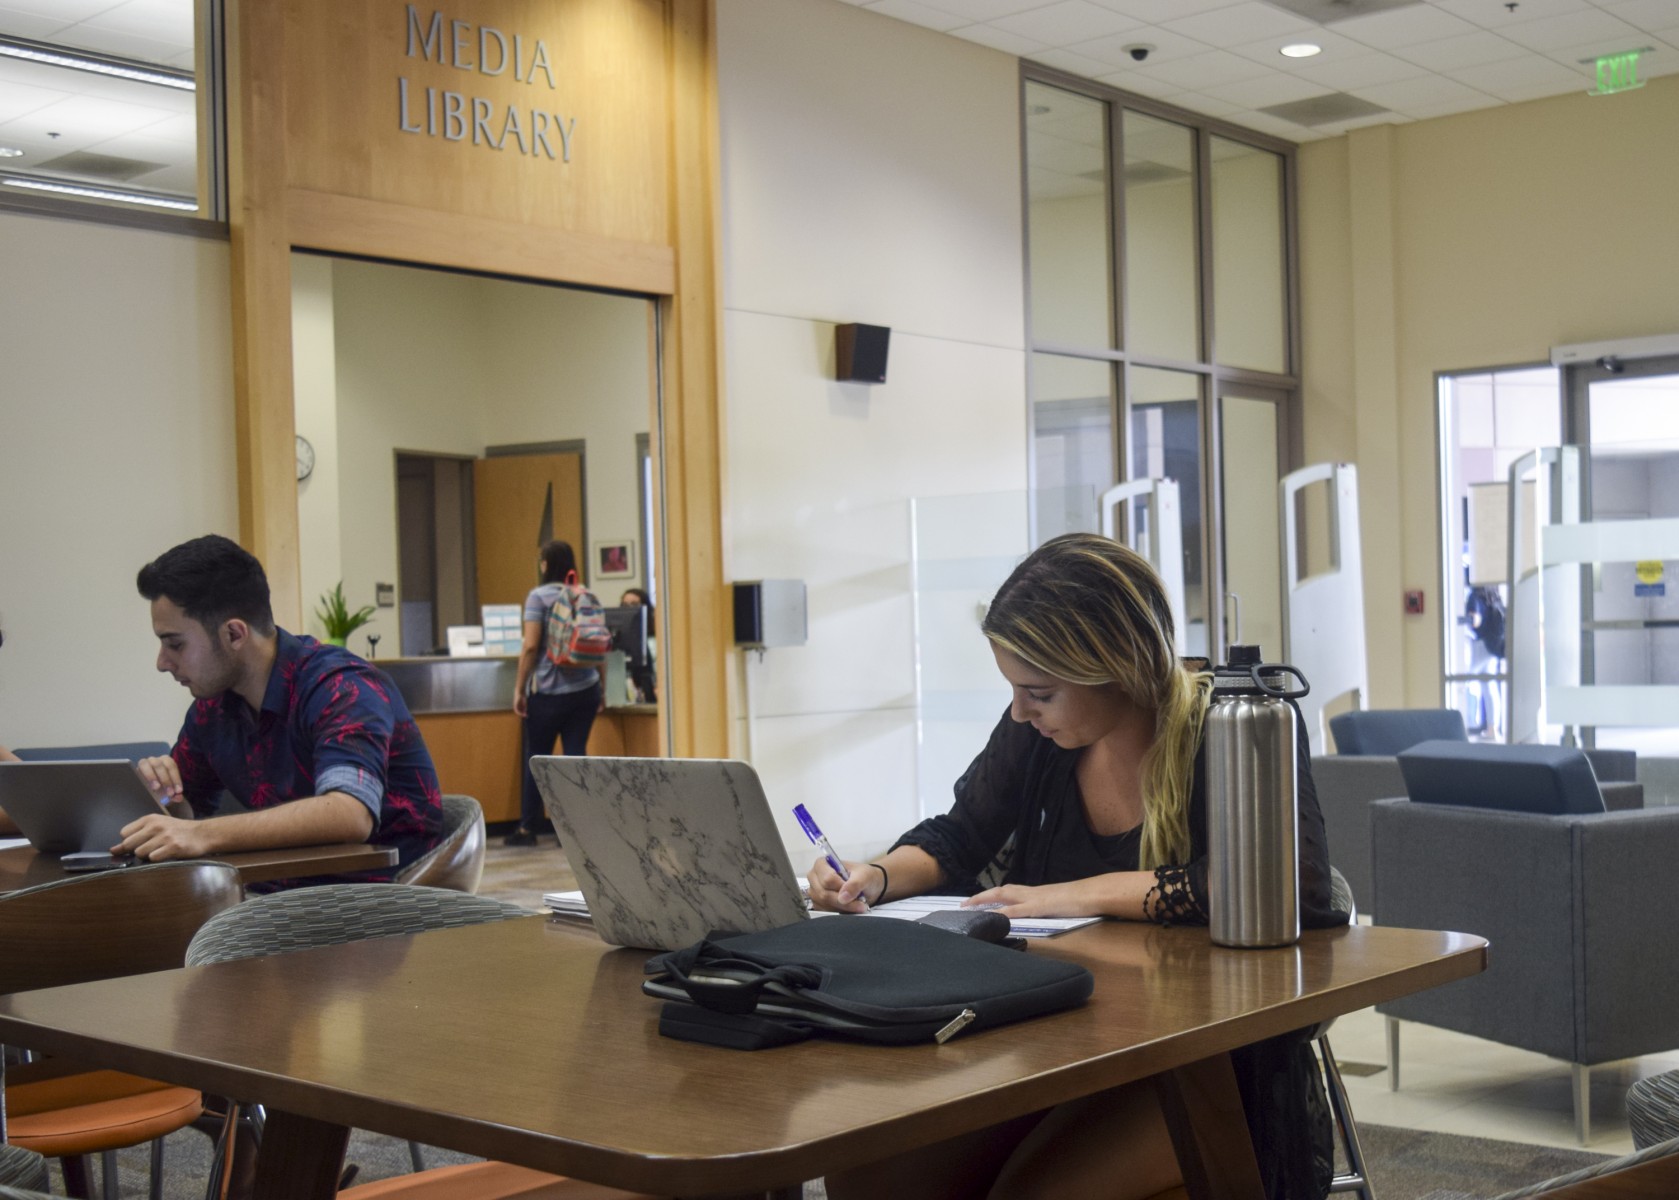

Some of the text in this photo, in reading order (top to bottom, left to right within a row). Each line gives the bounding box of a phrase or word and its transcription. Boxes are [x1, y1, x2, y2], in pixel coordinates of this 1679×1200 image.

[407, 4, 555, 90] MEDIA
[1596, 53, 1639, 91] EXIT
[399, 77, 576, 163] LIBRARY
